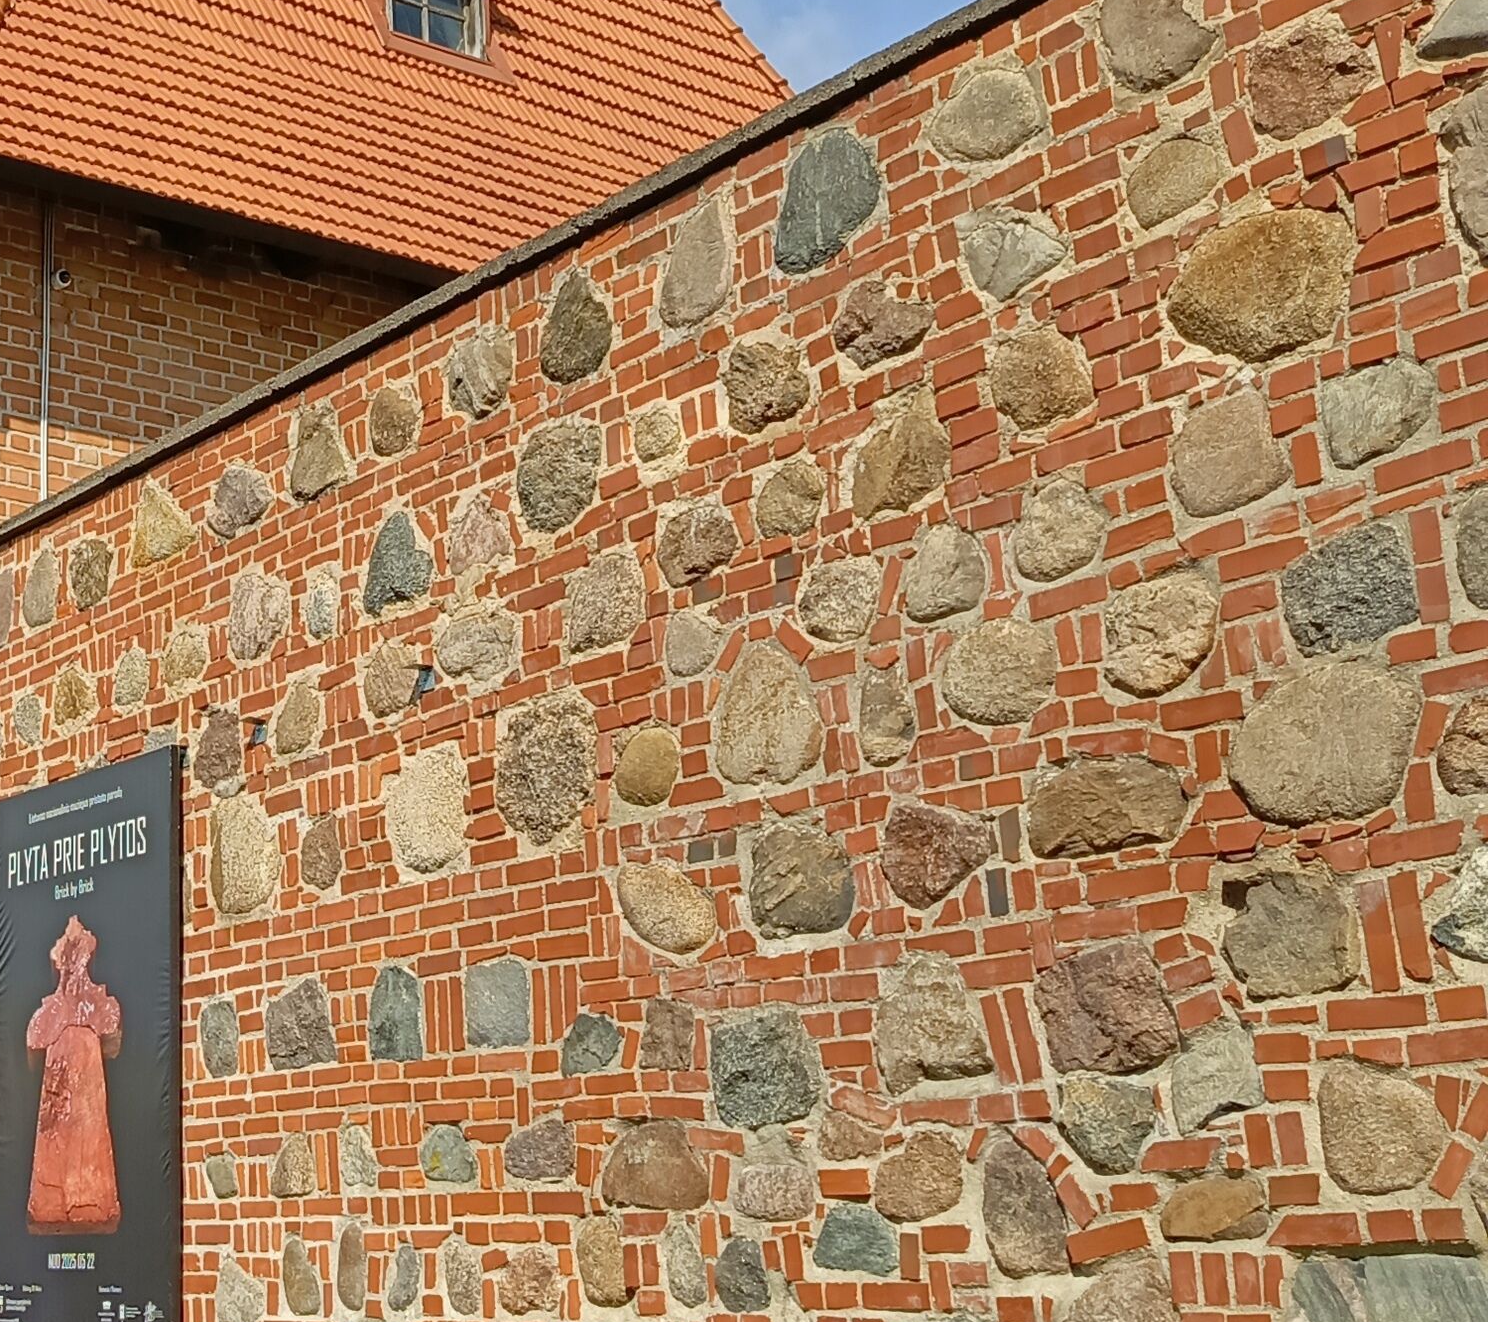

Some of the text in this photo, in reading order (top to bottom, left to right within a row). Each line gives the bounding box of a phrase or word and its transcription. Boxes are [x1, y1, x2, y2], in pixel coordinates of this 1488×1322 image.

[8, 816, 147, 889] PLYTA PRIE PLYTOS
[55, 877, 94, 900] Brick by Brick
[61, 1252, 77, 1270] 2025
[86, 1252, 95, 1270] 22
